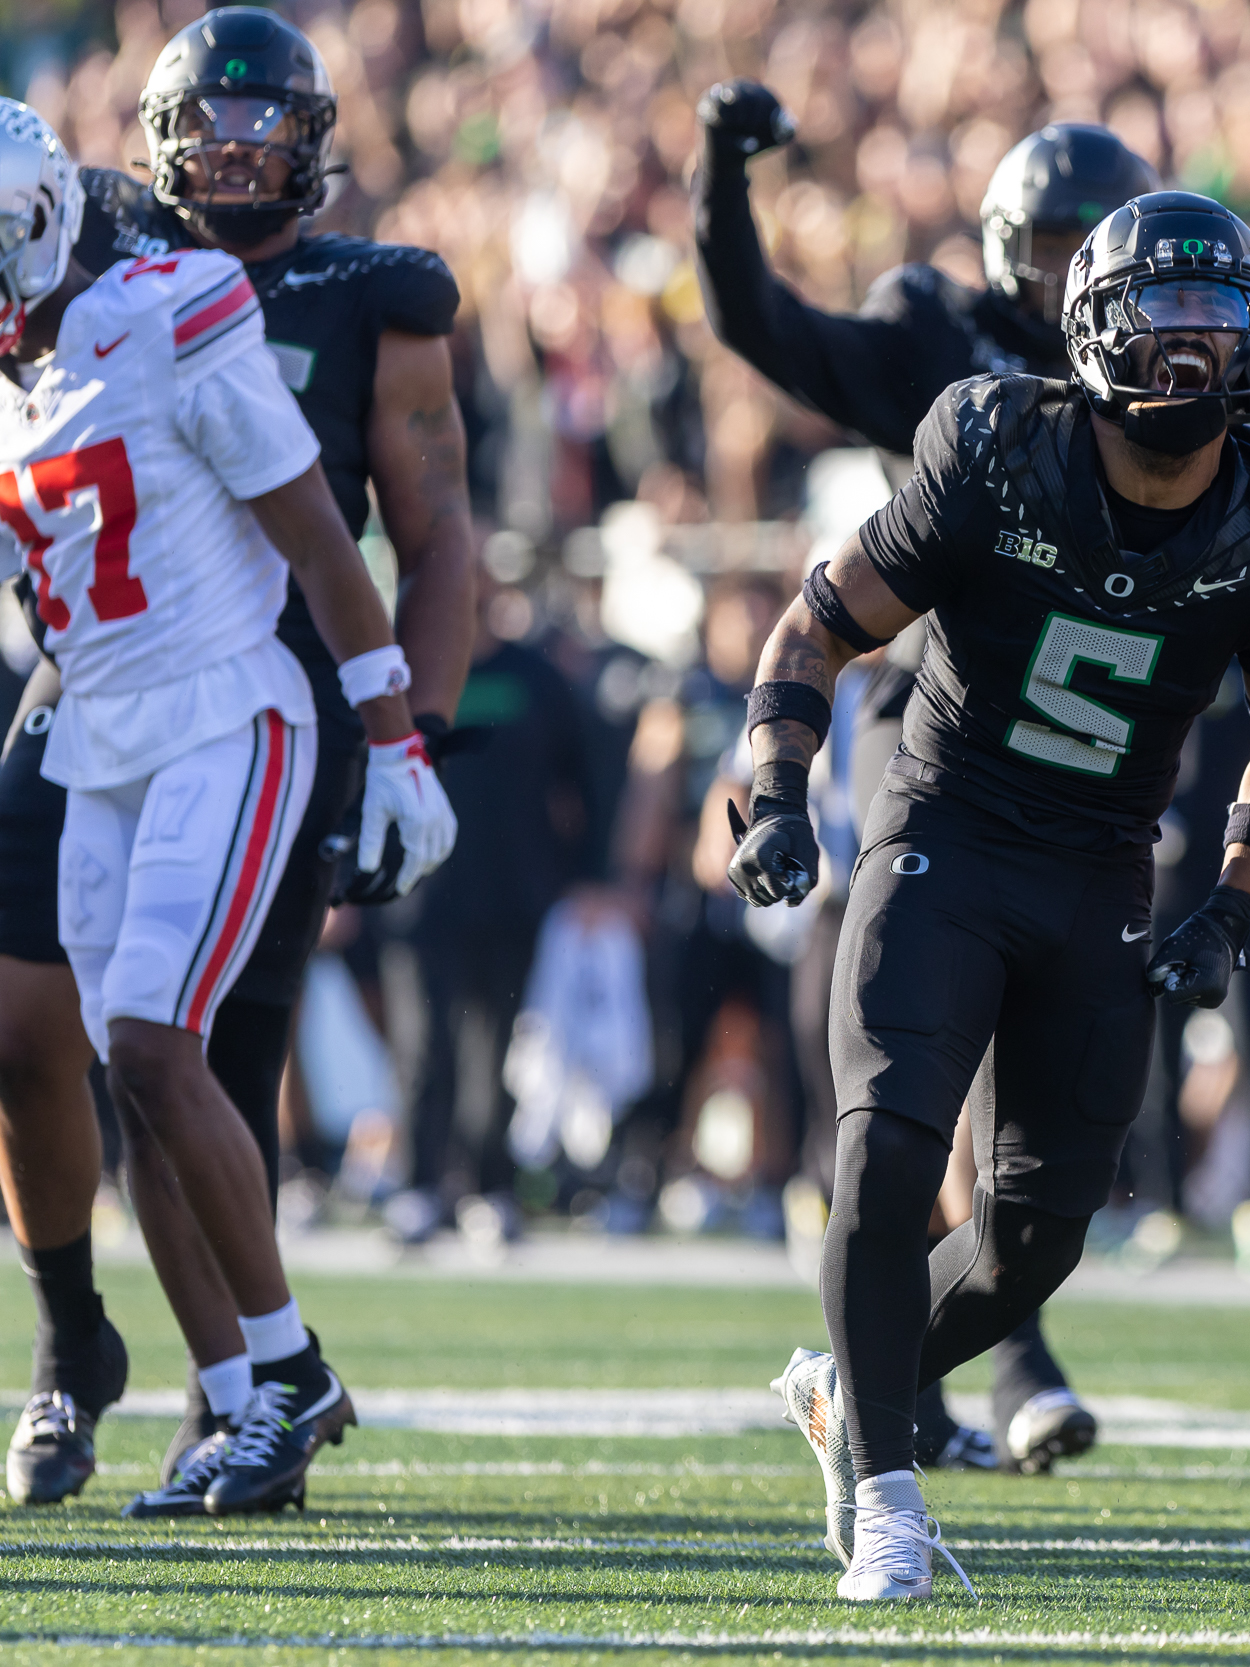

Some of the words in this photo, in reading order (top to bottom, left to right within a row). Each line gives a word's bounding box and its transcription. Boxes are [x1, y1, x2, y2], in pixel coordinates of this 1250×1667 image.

[1182, 239, 1204, 255] O
[0, 433, 148, 632] 17
[1104, 573, 1135, 598] O
[1003, 611, 1165, 778] 5
[891, 852, 930, 875] O
